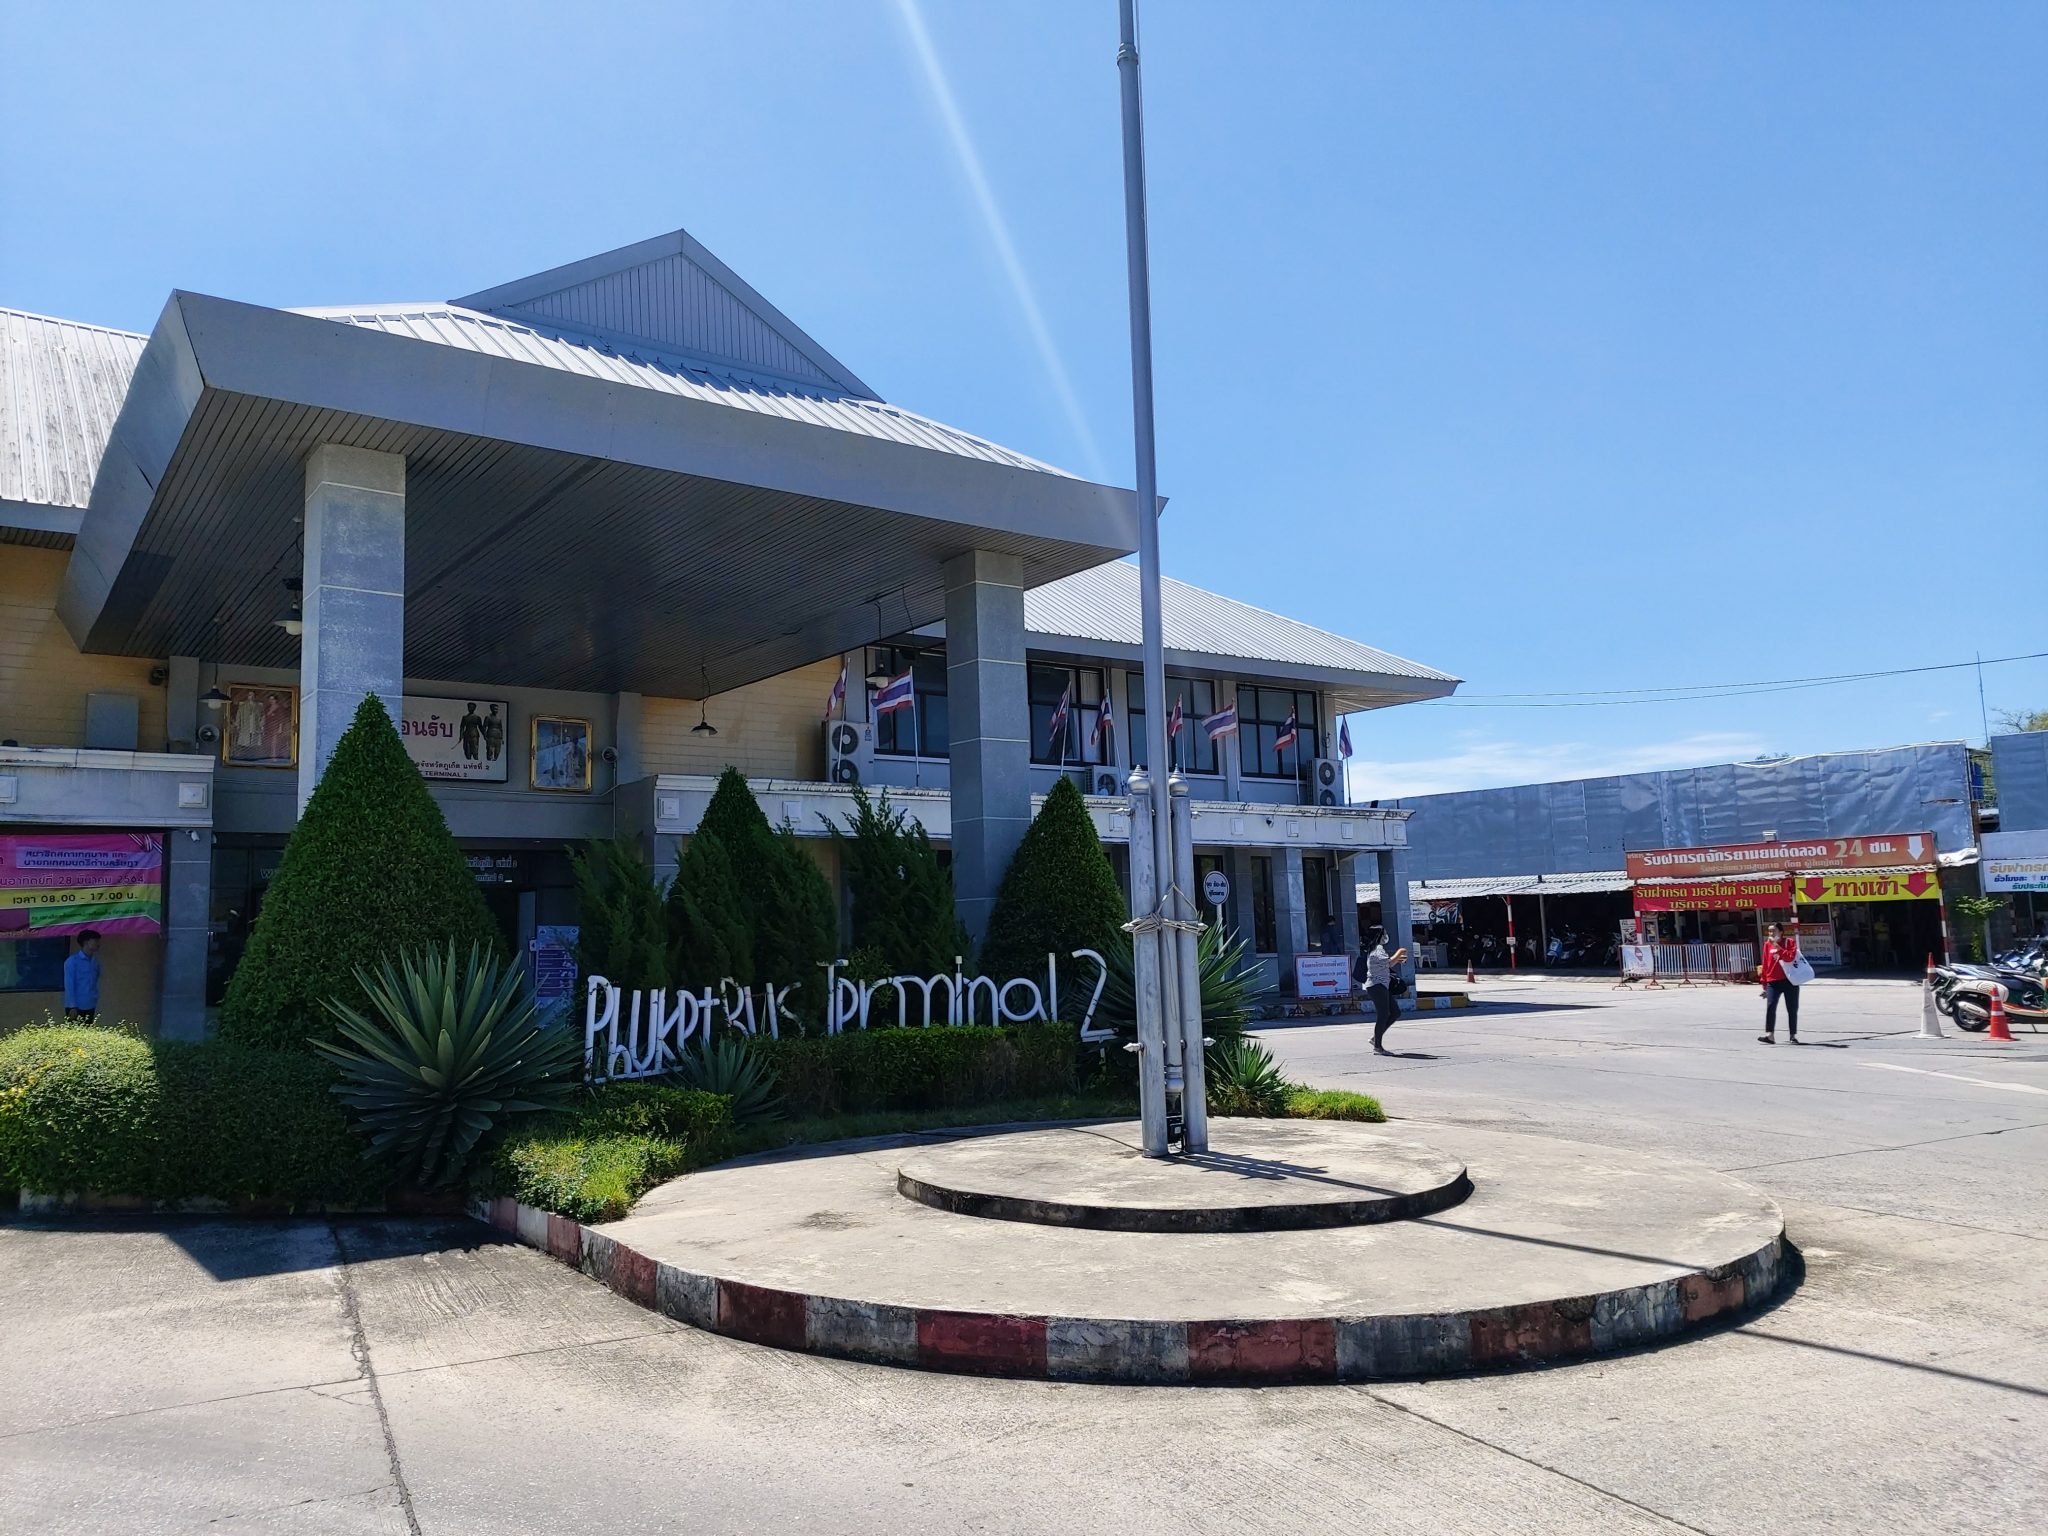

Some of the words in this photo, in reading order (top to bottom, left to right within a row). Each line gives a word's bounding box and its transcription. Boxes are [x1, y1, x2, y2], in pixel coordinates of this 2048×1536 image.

[425, 770, 461, 778] TERMINAL
[1834, 839, 1864, 858] 24
[58, 876, 72, 885] 28
[117, 874, 144, 883] 2564
[1636, 885, 1688, 898] รับฝากรถ
[1834, 875, 1899, 897] ทางเข้า
[13, 896, 36, 904] เวลา
[41, 894, 76, 903] 08.00
[91, 892, 123, 901] 17.00
[1669, 898, 1709, 909] บริการ
[1714, 900, 1729, 908] 24
[1071, 948, 1119, 1042] 2
